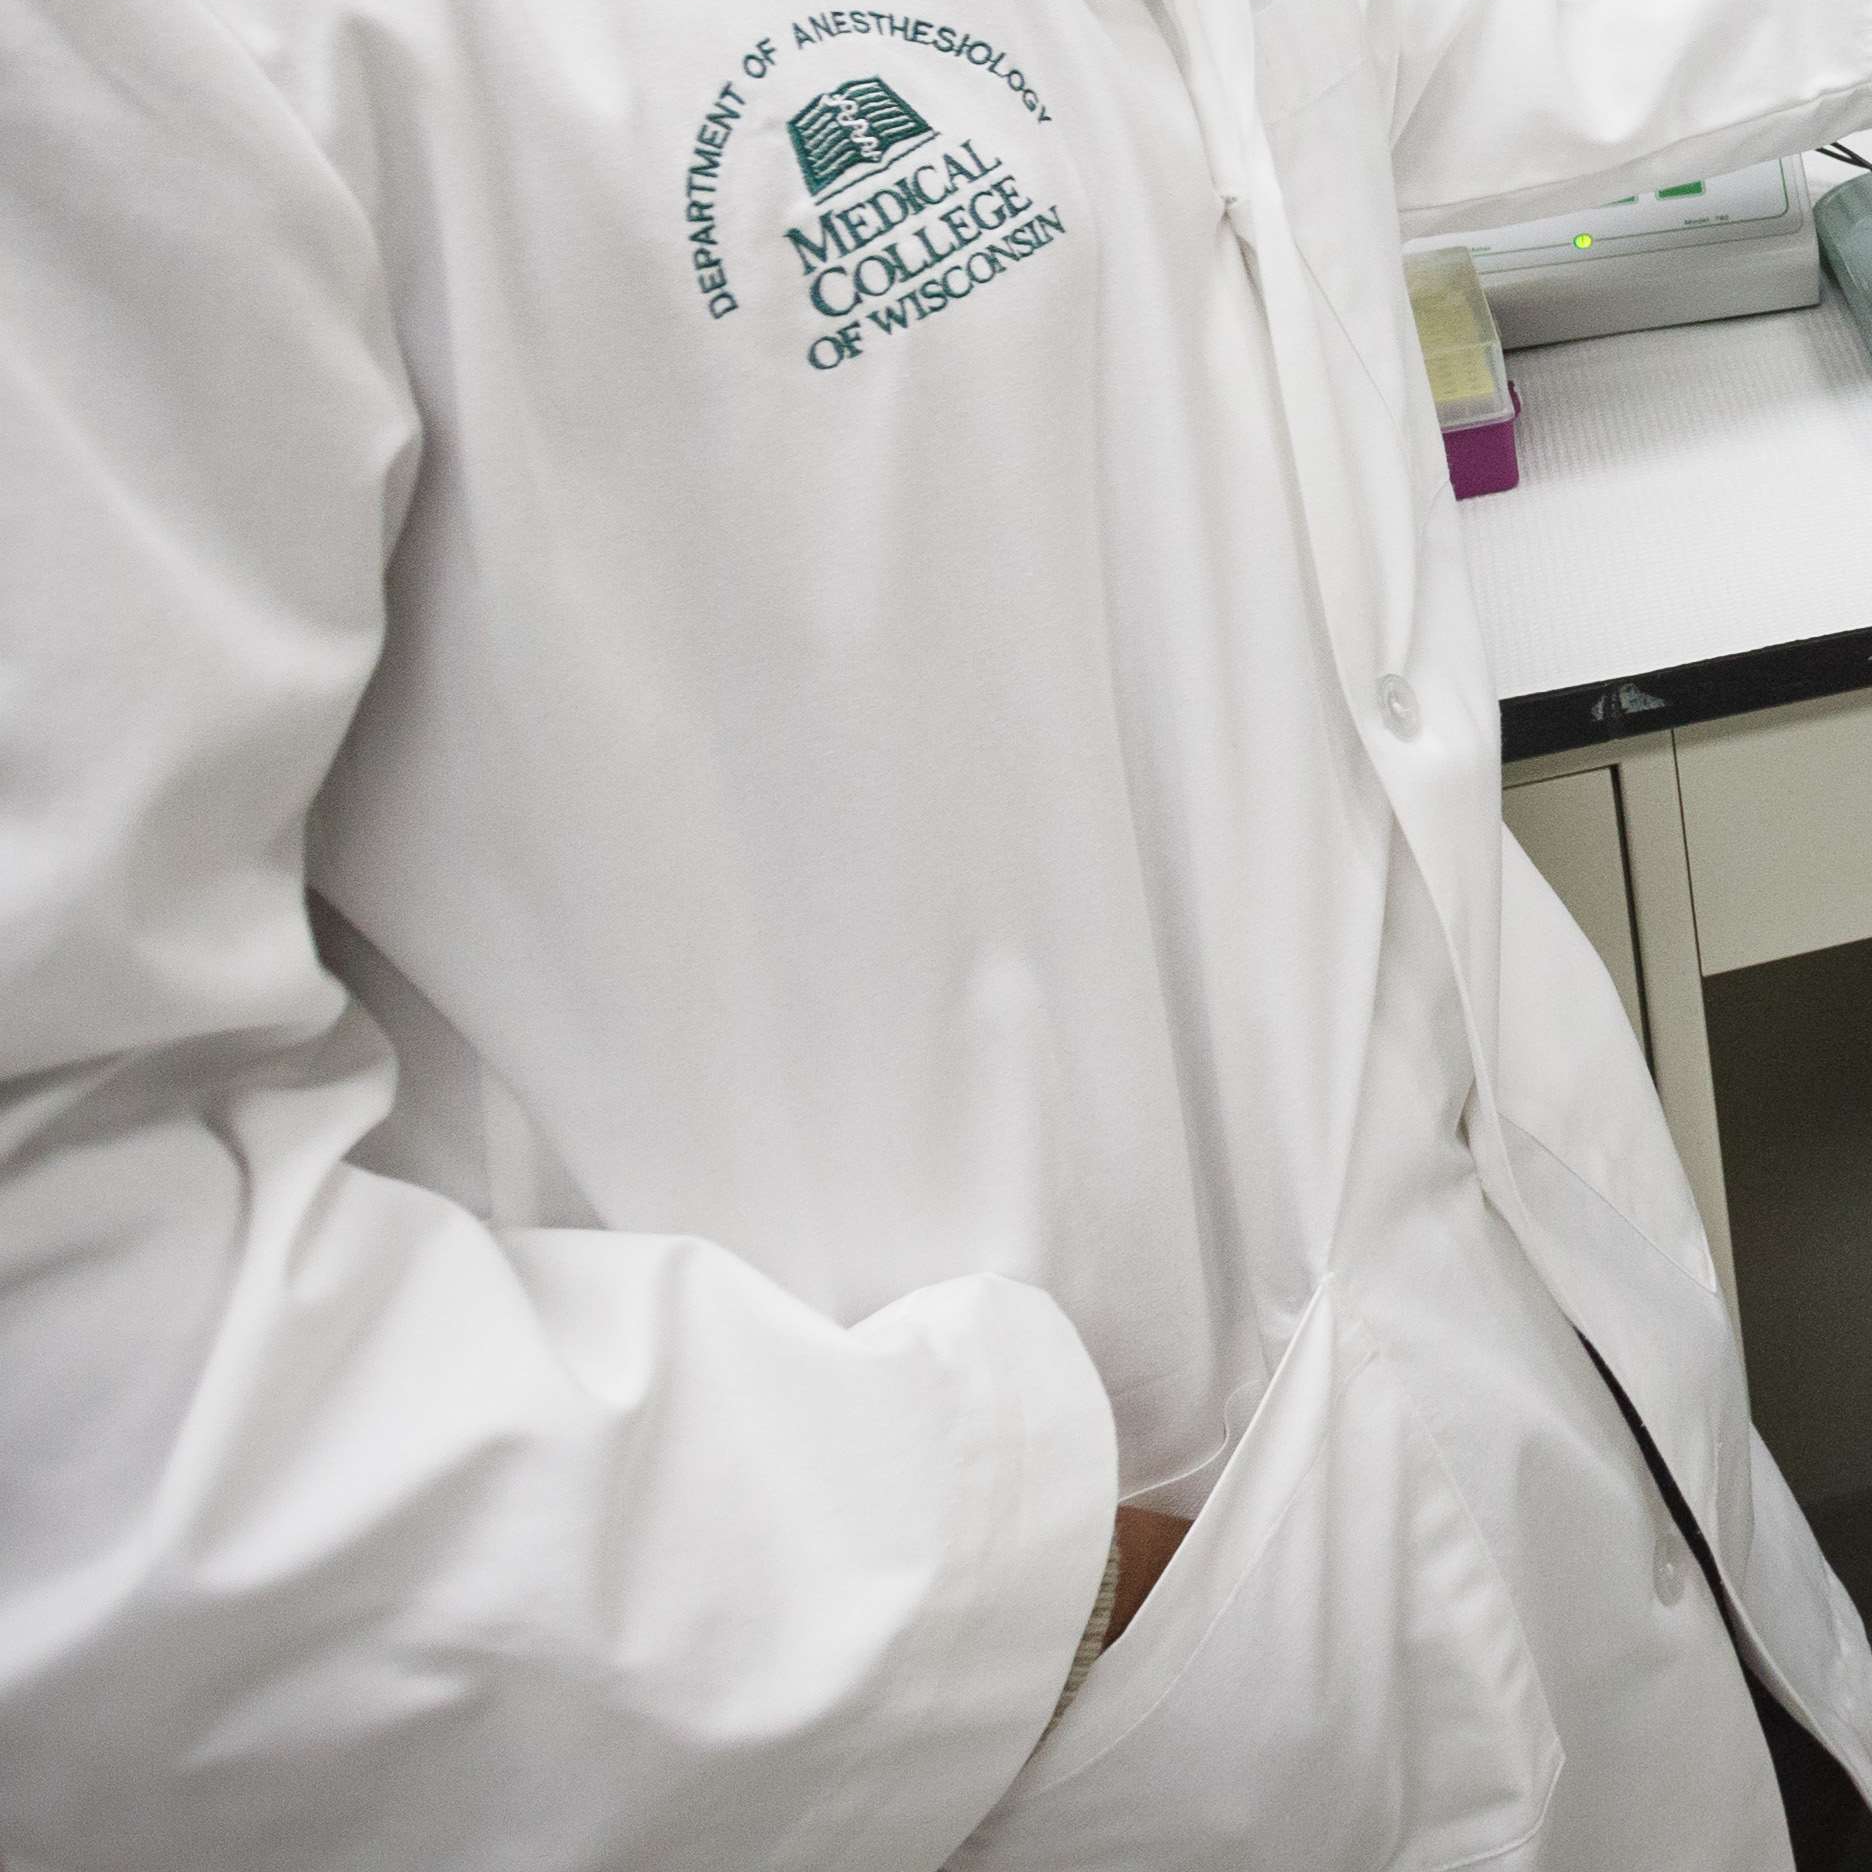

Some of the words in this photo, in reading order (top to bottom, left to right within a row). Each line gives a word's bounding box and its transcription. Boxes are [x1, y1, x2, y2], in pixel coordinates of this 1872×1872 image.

[685, 82, 746, 319] DEPARTMENT
[742, 38, 777, 79] OF
[791, 10, 1052, 124] ANESTHESIOLOGY
[783, 139, 1002, 275] MEDICAL
[807, 321, 863, 370] OF
[867, 205, 1066, 336] WISCONSIN
[809, 174, 1033, 317] COLLEGE
